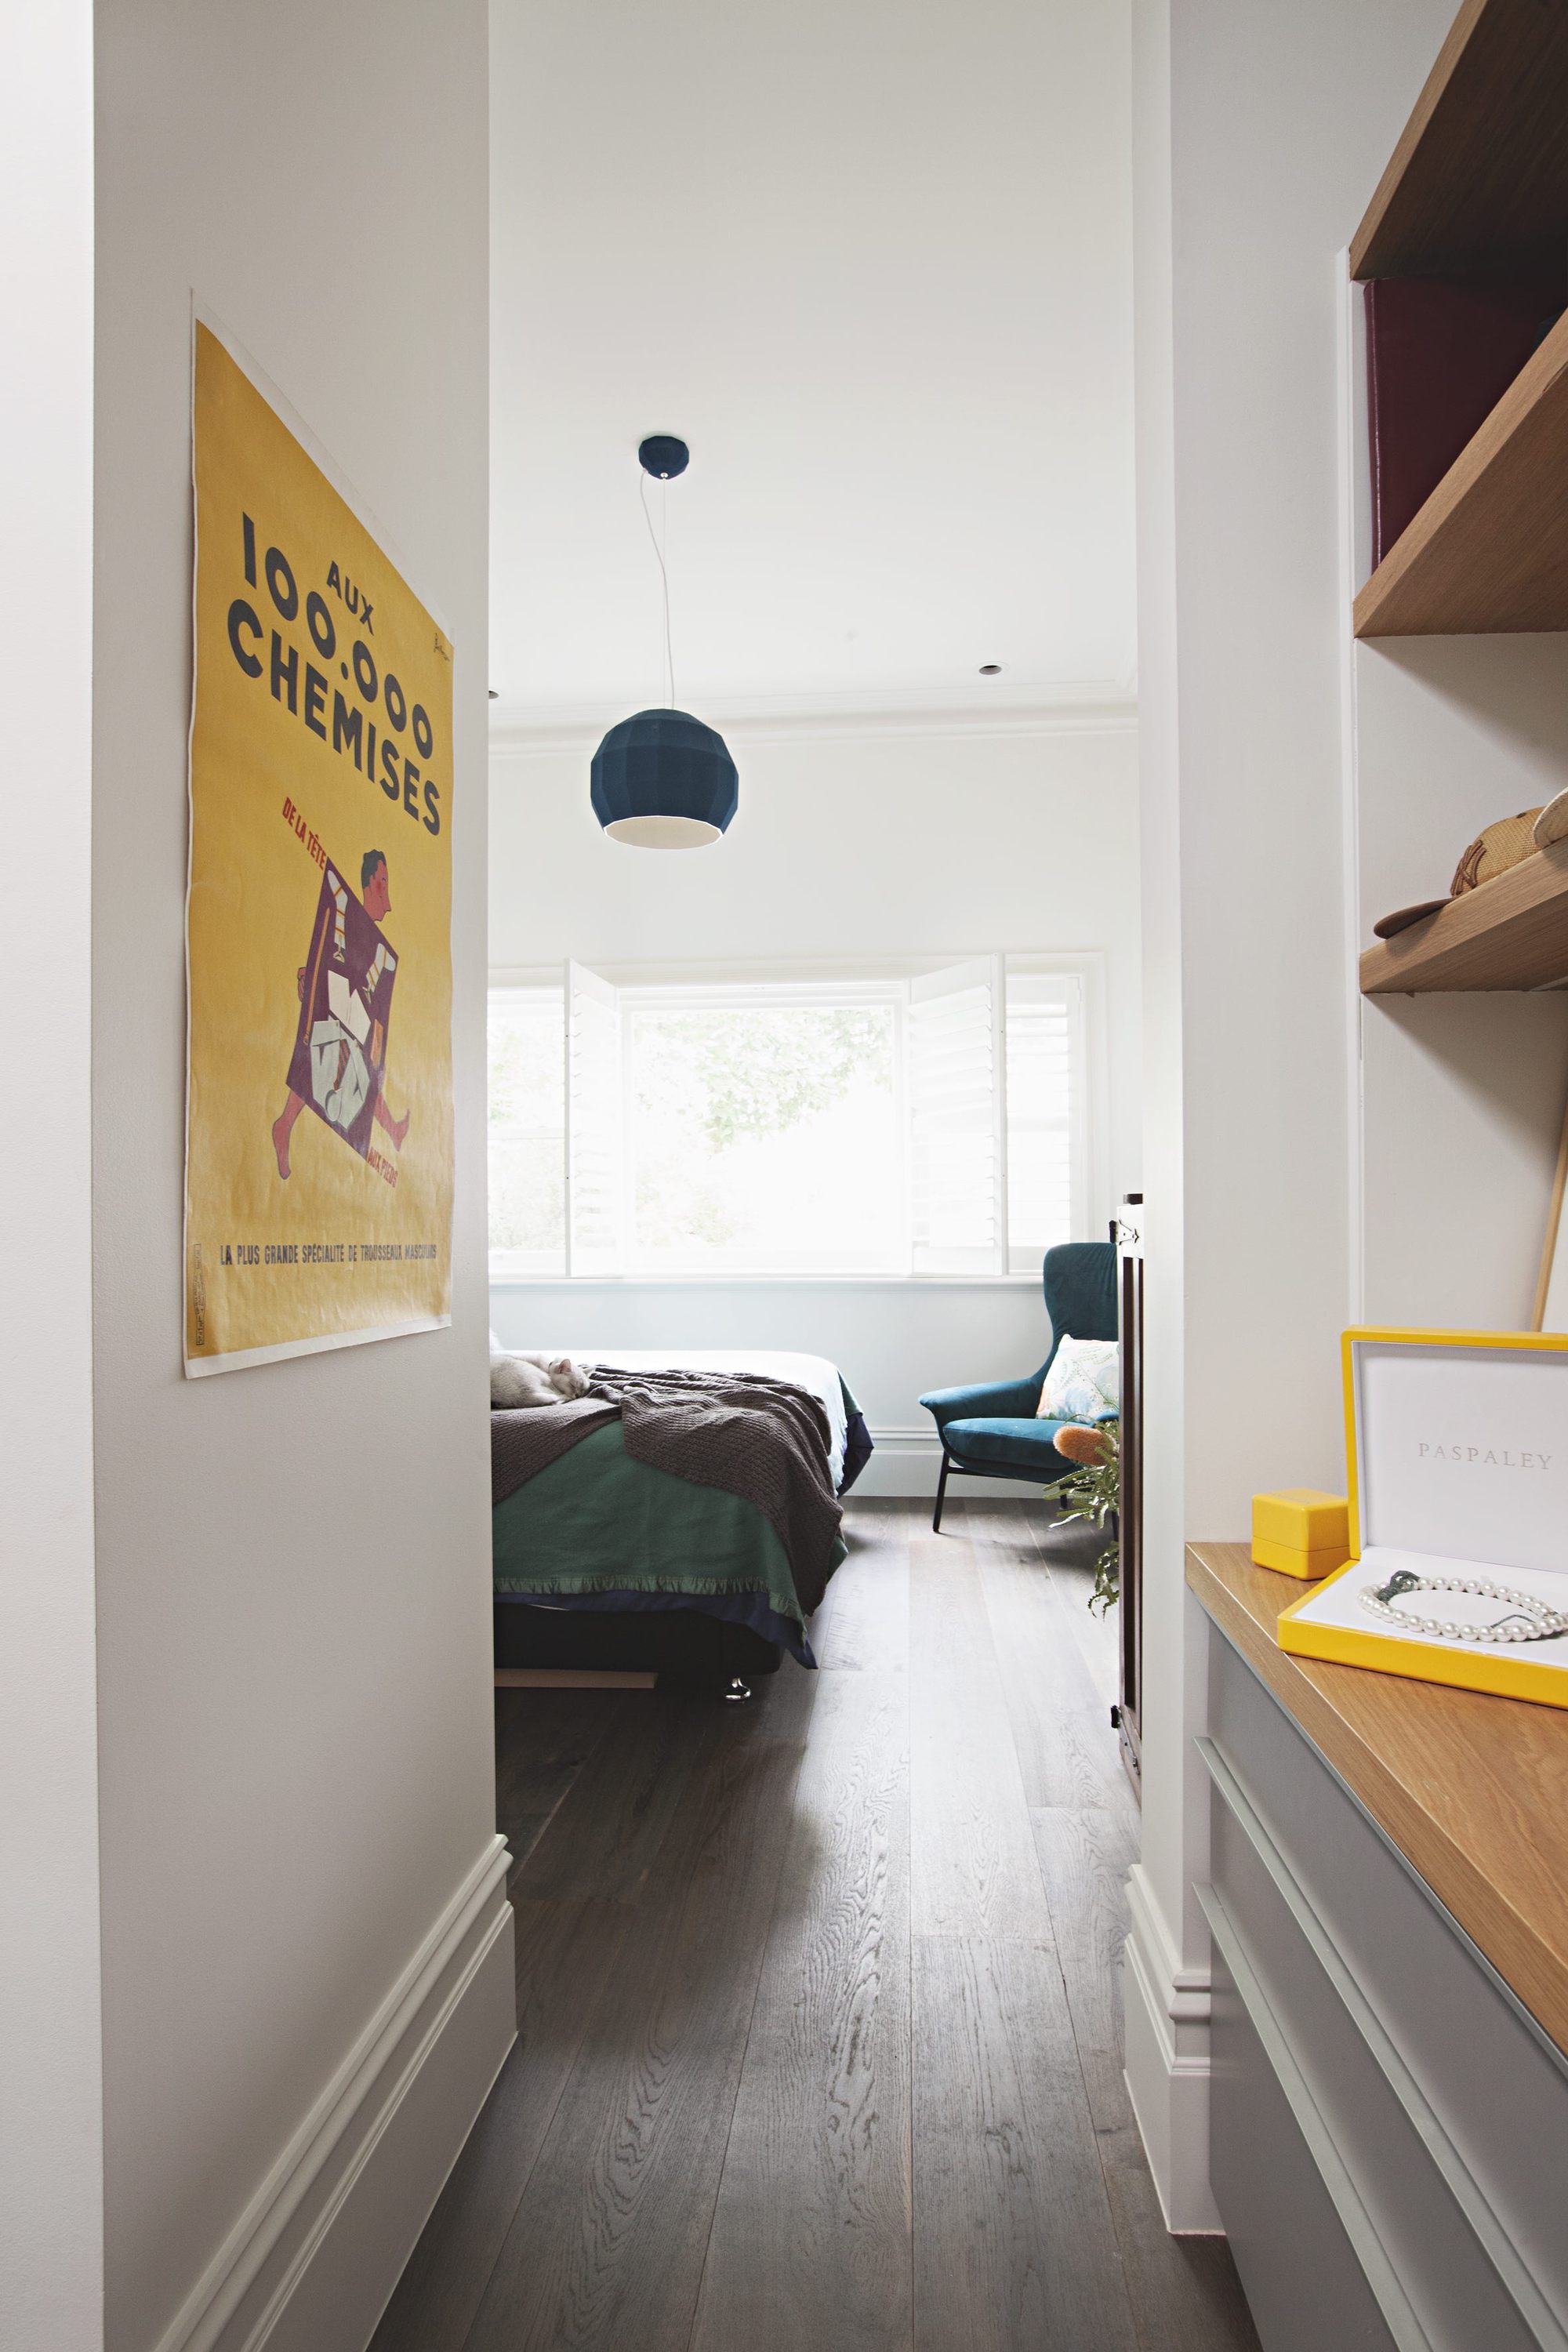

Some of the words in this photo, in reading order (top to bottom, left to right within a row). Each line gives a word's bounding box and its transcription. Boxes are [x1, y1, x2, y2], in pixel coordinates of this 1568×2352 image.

[326, 560, 374, 634] AUX
[227, 599, 441, 837] CHEMISES
[282, 797, 297, 828] DE
[295, 815, 307, 844] LA
[307, 830, 327, 870] TÊTE
[220, 1244, 233, 1265] LA
[237, 1244, 260, 1265] PLUS
[264, 1244, 299, 1265] GRANDE
[301, 1243, 345, 1263] SPÉCIALITÉ
[348, 1244, 358, 1262] DE
[360, 1244, 403, 1261] TROUSSEAUX
[1418, 1443, 1553, 1470] PASPALEY
